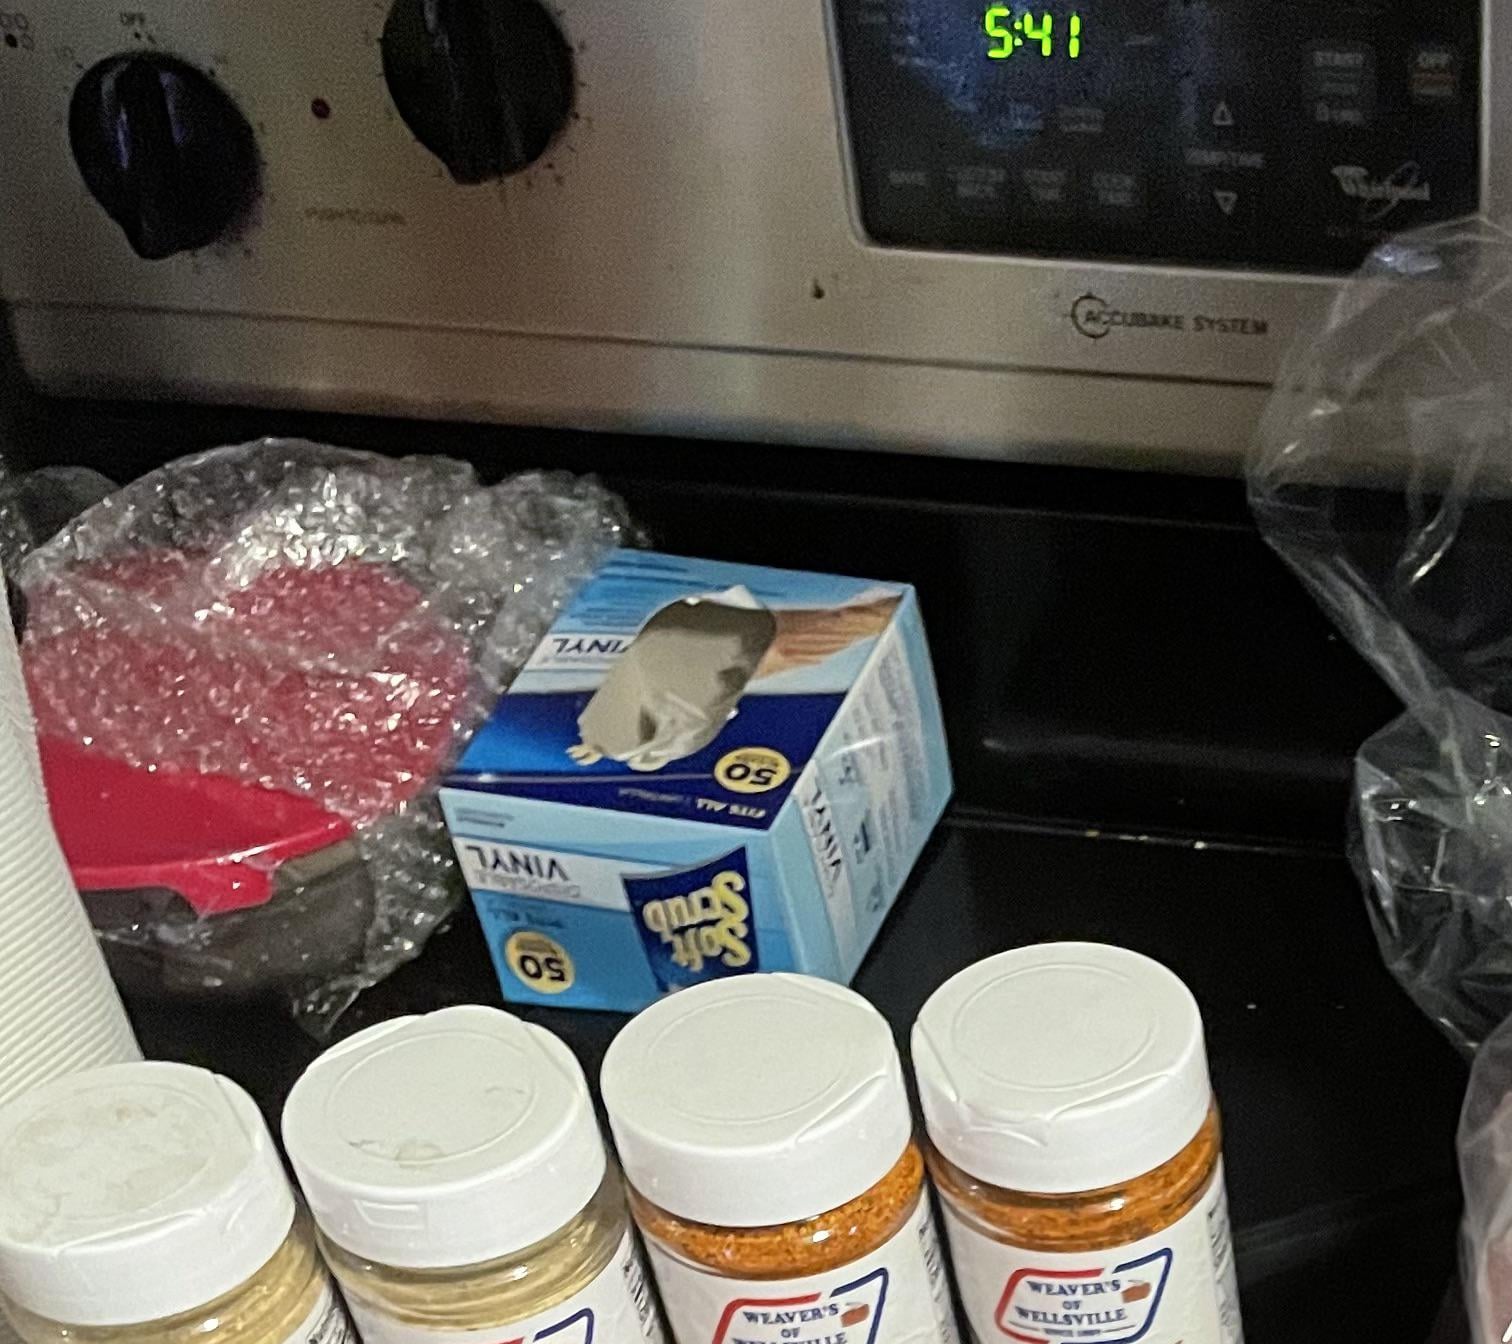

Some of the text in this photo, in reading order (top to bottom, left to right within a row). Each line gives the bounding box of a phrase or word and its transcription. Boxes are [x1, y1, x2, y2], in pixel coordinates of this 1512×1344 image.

[985, 5, 1081, 58] 5:41
[1192, 313, 1267, 334] SYSTEM
[553, 638, 629, 656] INYL
[726, 763, 777, 786] 50
[466, 846, 570, 882] VINYL
[642, 870, 752, 936] Scrub
[668, 919, 753, 973] Soft
[519, 955, 567, 983] 50
[1026, 1280, 1121, 1296] WEAVER'S
[742, 1303, 840, 1325] WEAVER'S
[1014, 1306, 1128, 1325] WELLSVILLE
